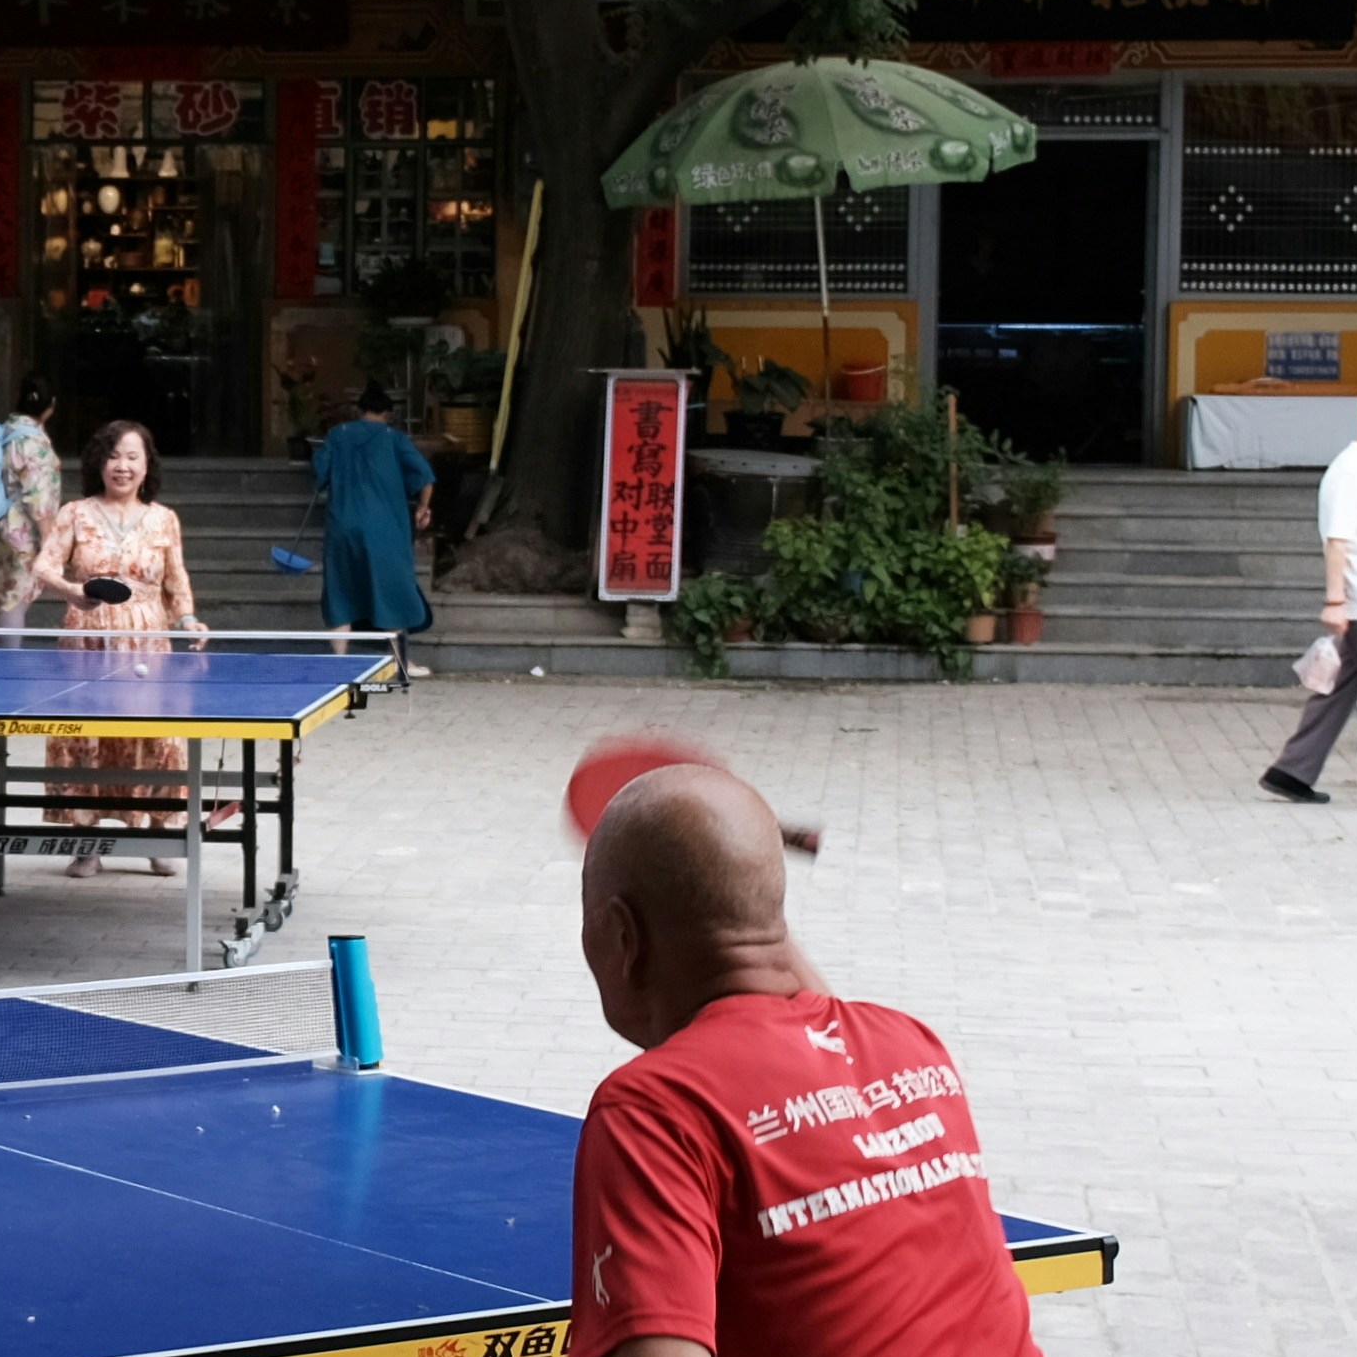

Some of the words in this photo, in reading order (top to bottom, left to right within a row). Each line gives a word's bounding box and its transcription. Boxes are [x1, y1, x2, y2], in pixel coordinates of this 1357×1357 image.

[61, 82, 240, 137] 紫砂
[609, 509, 674, 548] 中堂
[608, 550, 672, 582] 扇面
